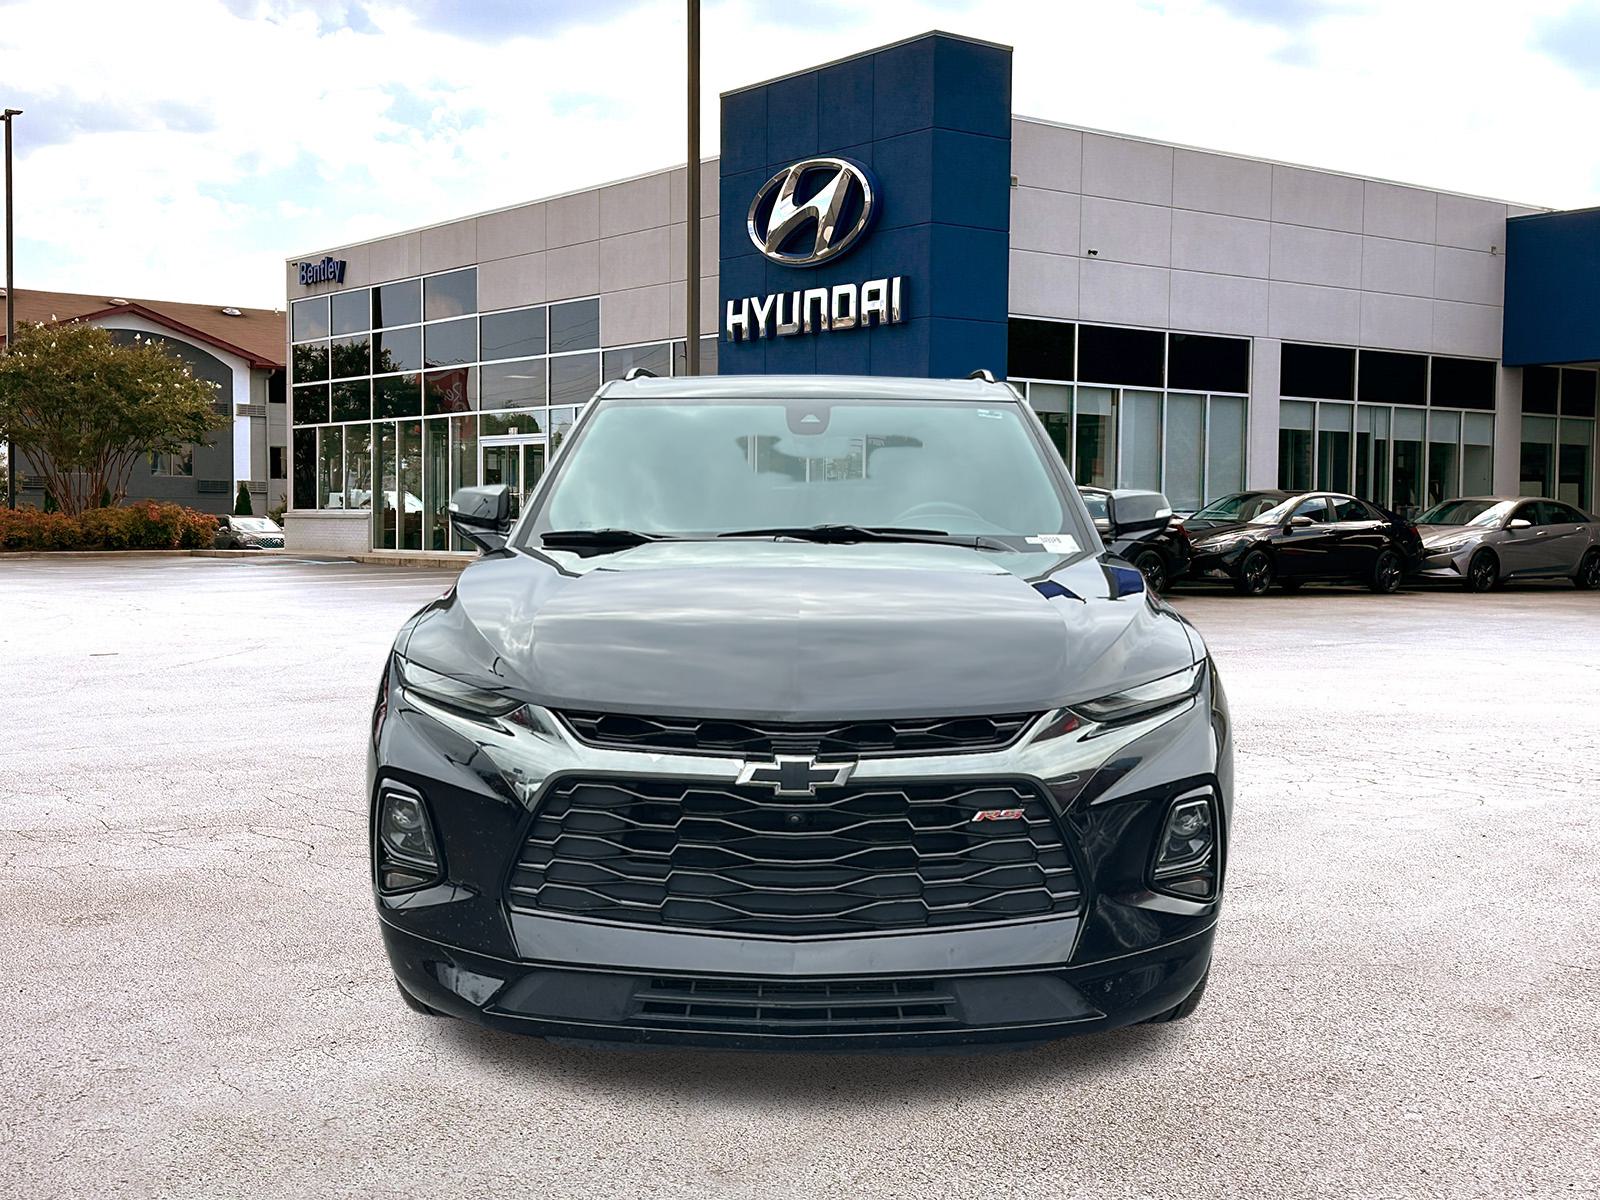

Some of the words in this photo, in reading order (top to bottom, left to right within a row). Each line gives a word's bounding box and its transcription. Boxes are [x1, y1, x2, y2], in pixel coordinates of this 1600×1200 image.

[299, 257, 344, 285] Bentley
[726, 276, 902, 342] HYUNDAI
[971, 808, 1025, 822] RS
